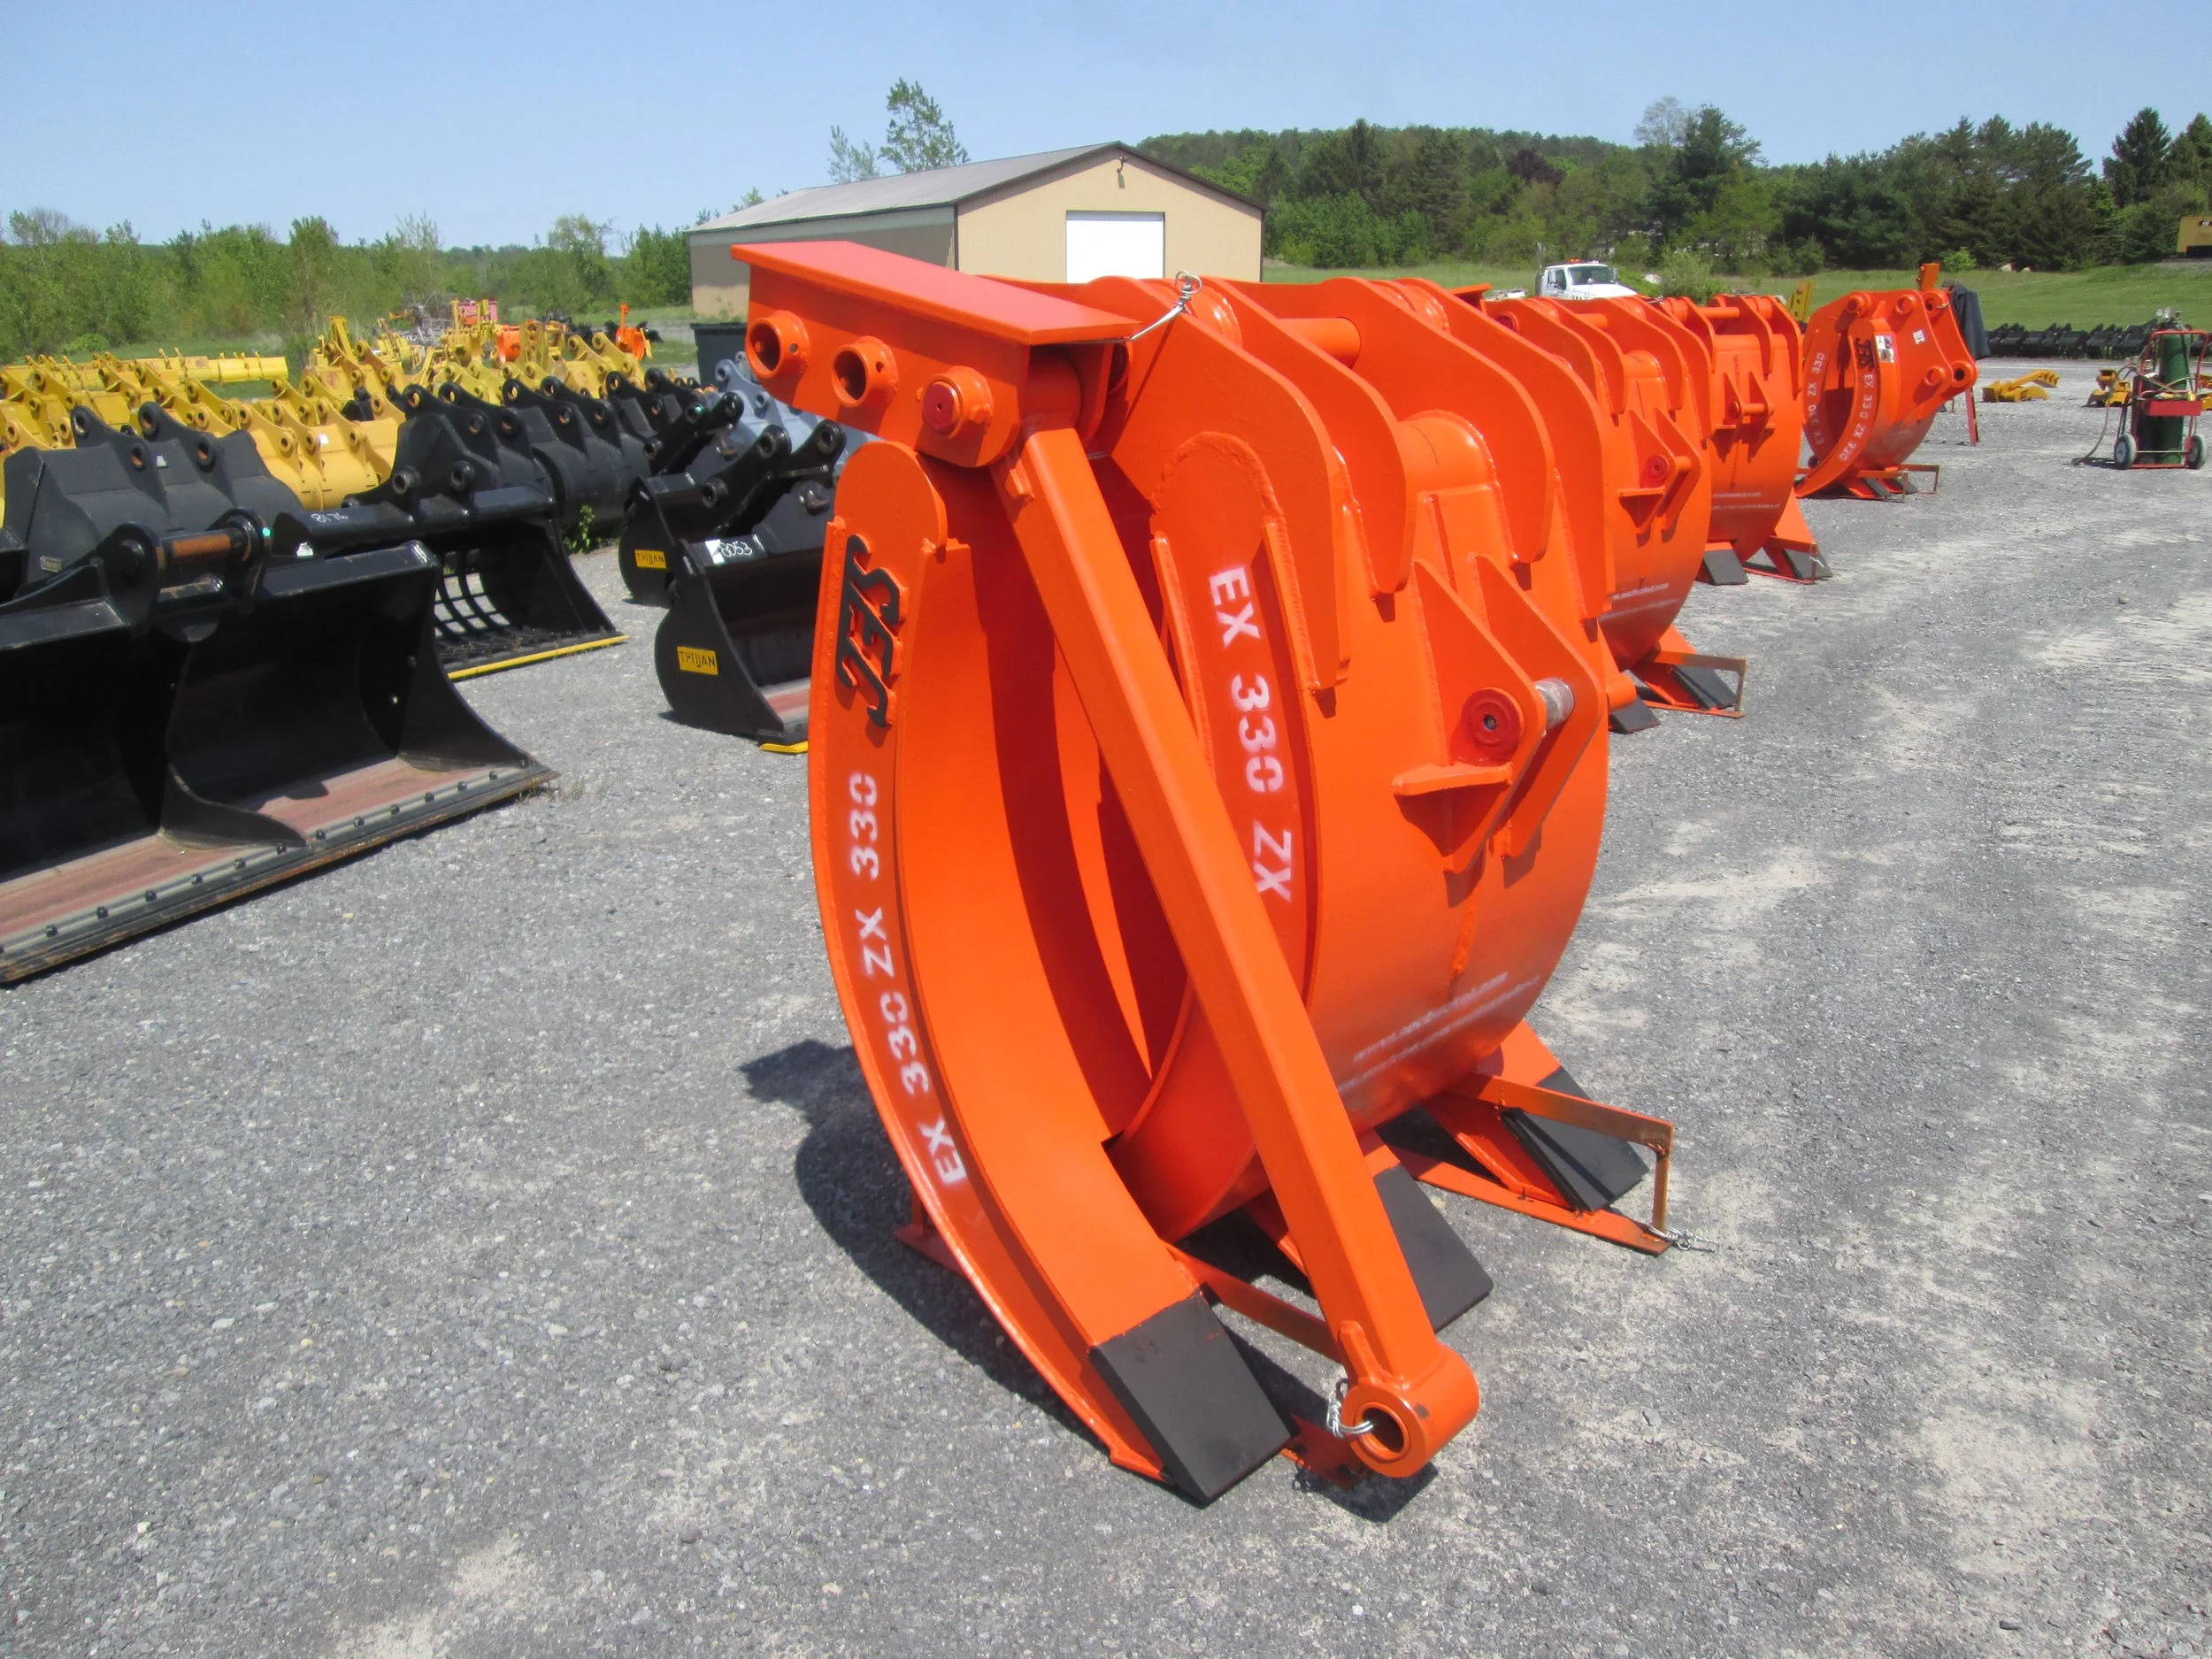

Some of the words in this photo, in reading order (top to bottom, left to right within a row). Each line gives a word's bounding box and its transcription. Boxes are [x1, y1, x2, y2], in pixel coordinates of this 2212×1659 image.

[1812, 352, 1824, 373] 330
[1864, 374, 1874, 388] EX
[1853, 423, 1866, 439] ZX
[1860, 395, 1872, 419] 330
[1839, 441, 1856, 460] 330
[1209, 566, 1262, 649] EX
[1230, 672, 1284, 793] 330
[849, 772, 879, 880] 330
[1253, 820, 1293, 902] ZX
[855, 907, 895, 978] ZX
[879, 991, 931, 1096] 330
[917, 1114, 968, 1187] EX
